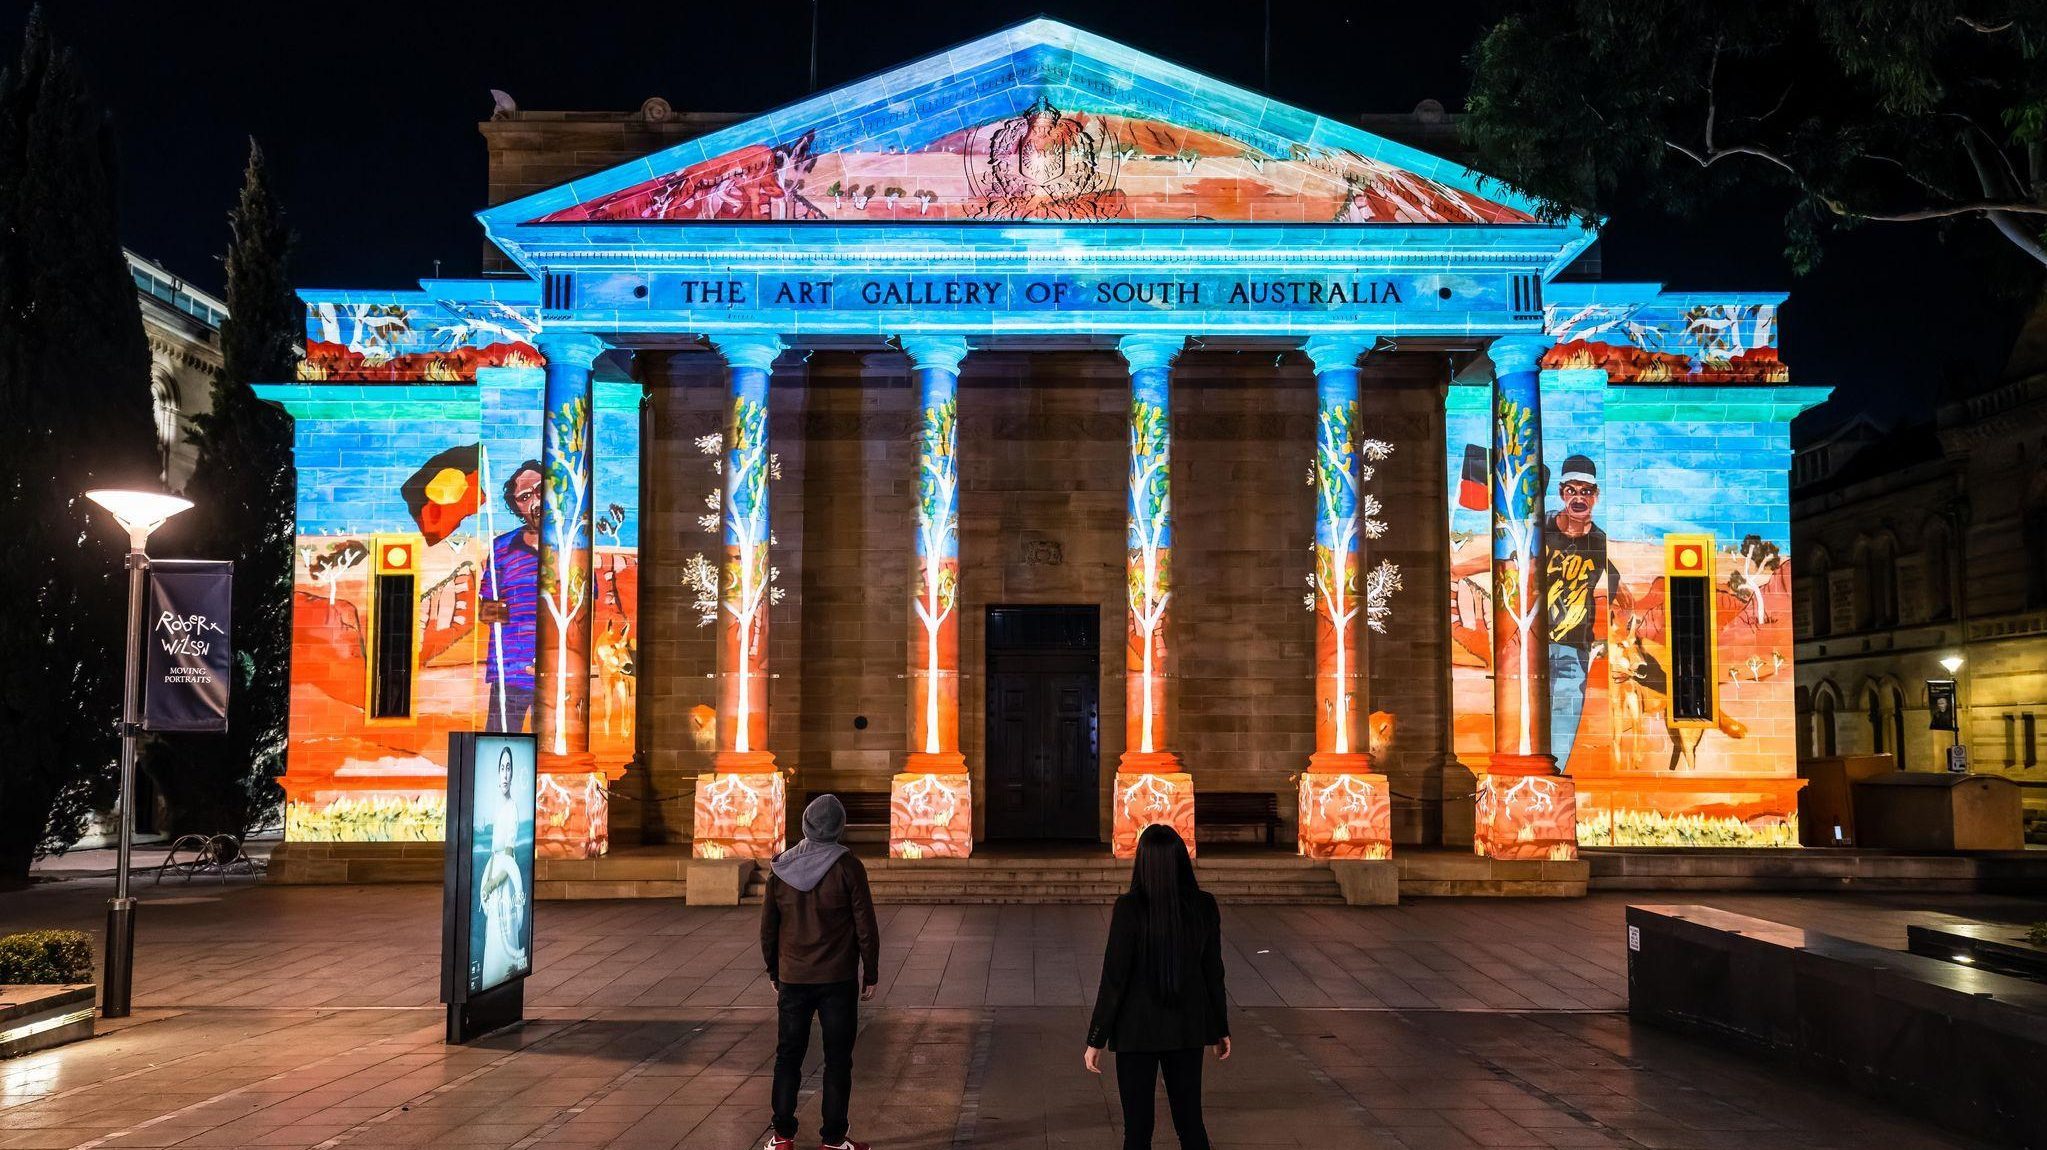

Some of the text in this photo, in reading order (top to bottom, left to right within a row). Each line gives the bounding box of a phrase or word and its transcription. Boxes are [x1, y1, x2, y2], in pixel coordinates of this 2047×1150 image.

[680, 280, 1402, 305] THE ART GALLERY OF SOUTH AUSTRALIA
[170, 667, 206, 675] MOVING
[164, 675, 211, 684] PORTRAITS
